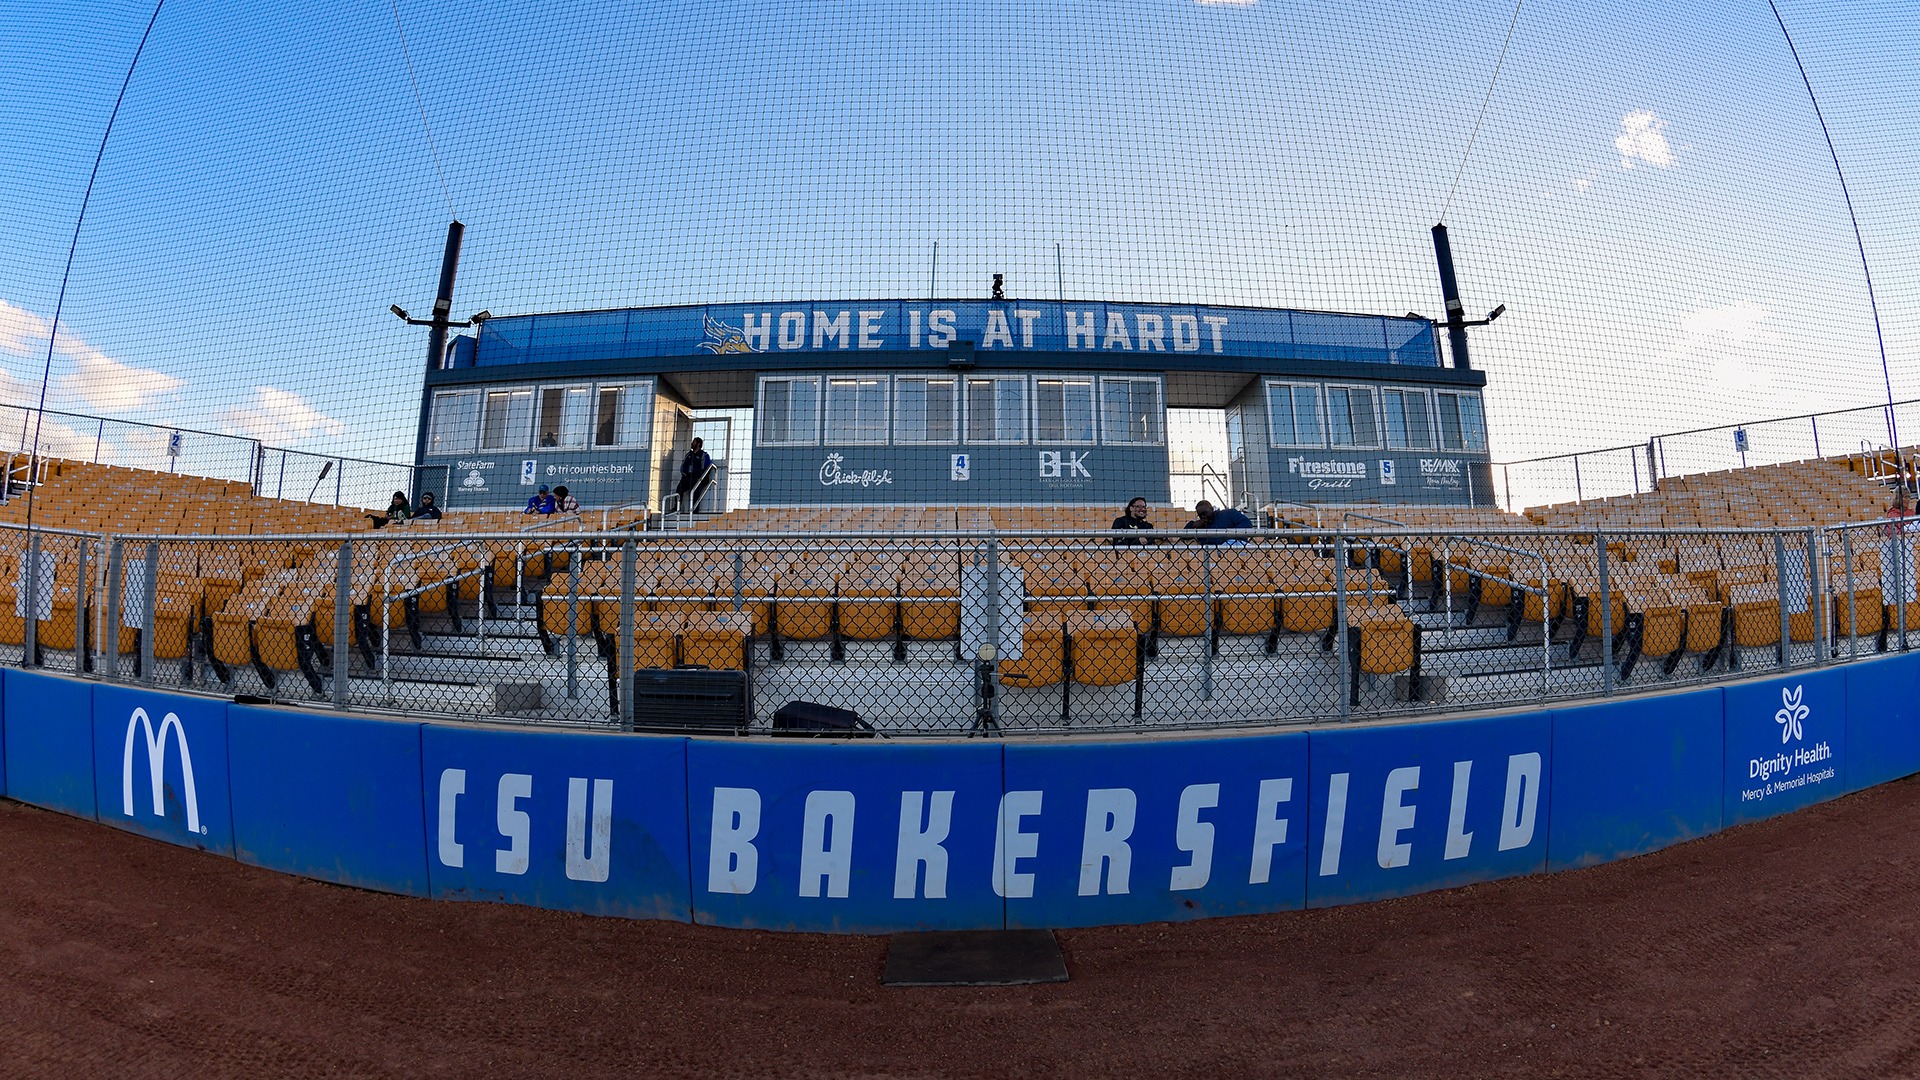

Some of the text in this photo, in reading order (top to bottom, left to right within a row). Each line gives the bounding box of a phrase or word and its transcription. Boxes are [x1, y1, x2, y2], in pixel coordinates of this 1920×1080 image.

[743, 309, 1229, 354] HOME IS AT HARDT
[171, 435, 180, 446] 2
[1736, 431, 1745, 442] 6
[525, 461, 534, 475] 3
[558, 463, 634, 475] tri counties bank
[956, 455, 966, 469] 4
[1039, 451, 1092, 477] BHK
[1288, 455, 1366, 474] Firestone
[1383, 461, 1391, 474] 5
[1420, 458, 1460, 473] RE/MAX
[819, 453, 892, 487] Chick-fil-A
[1308, 479, 1352, 490] Grill
[1749, 741, 1830, 781] Dignity Health
[1742, 766, 1835, 802] Mercy & Memorial Hospitals
[438, 752, 1541, 899] CSU BAKERSFIELD
